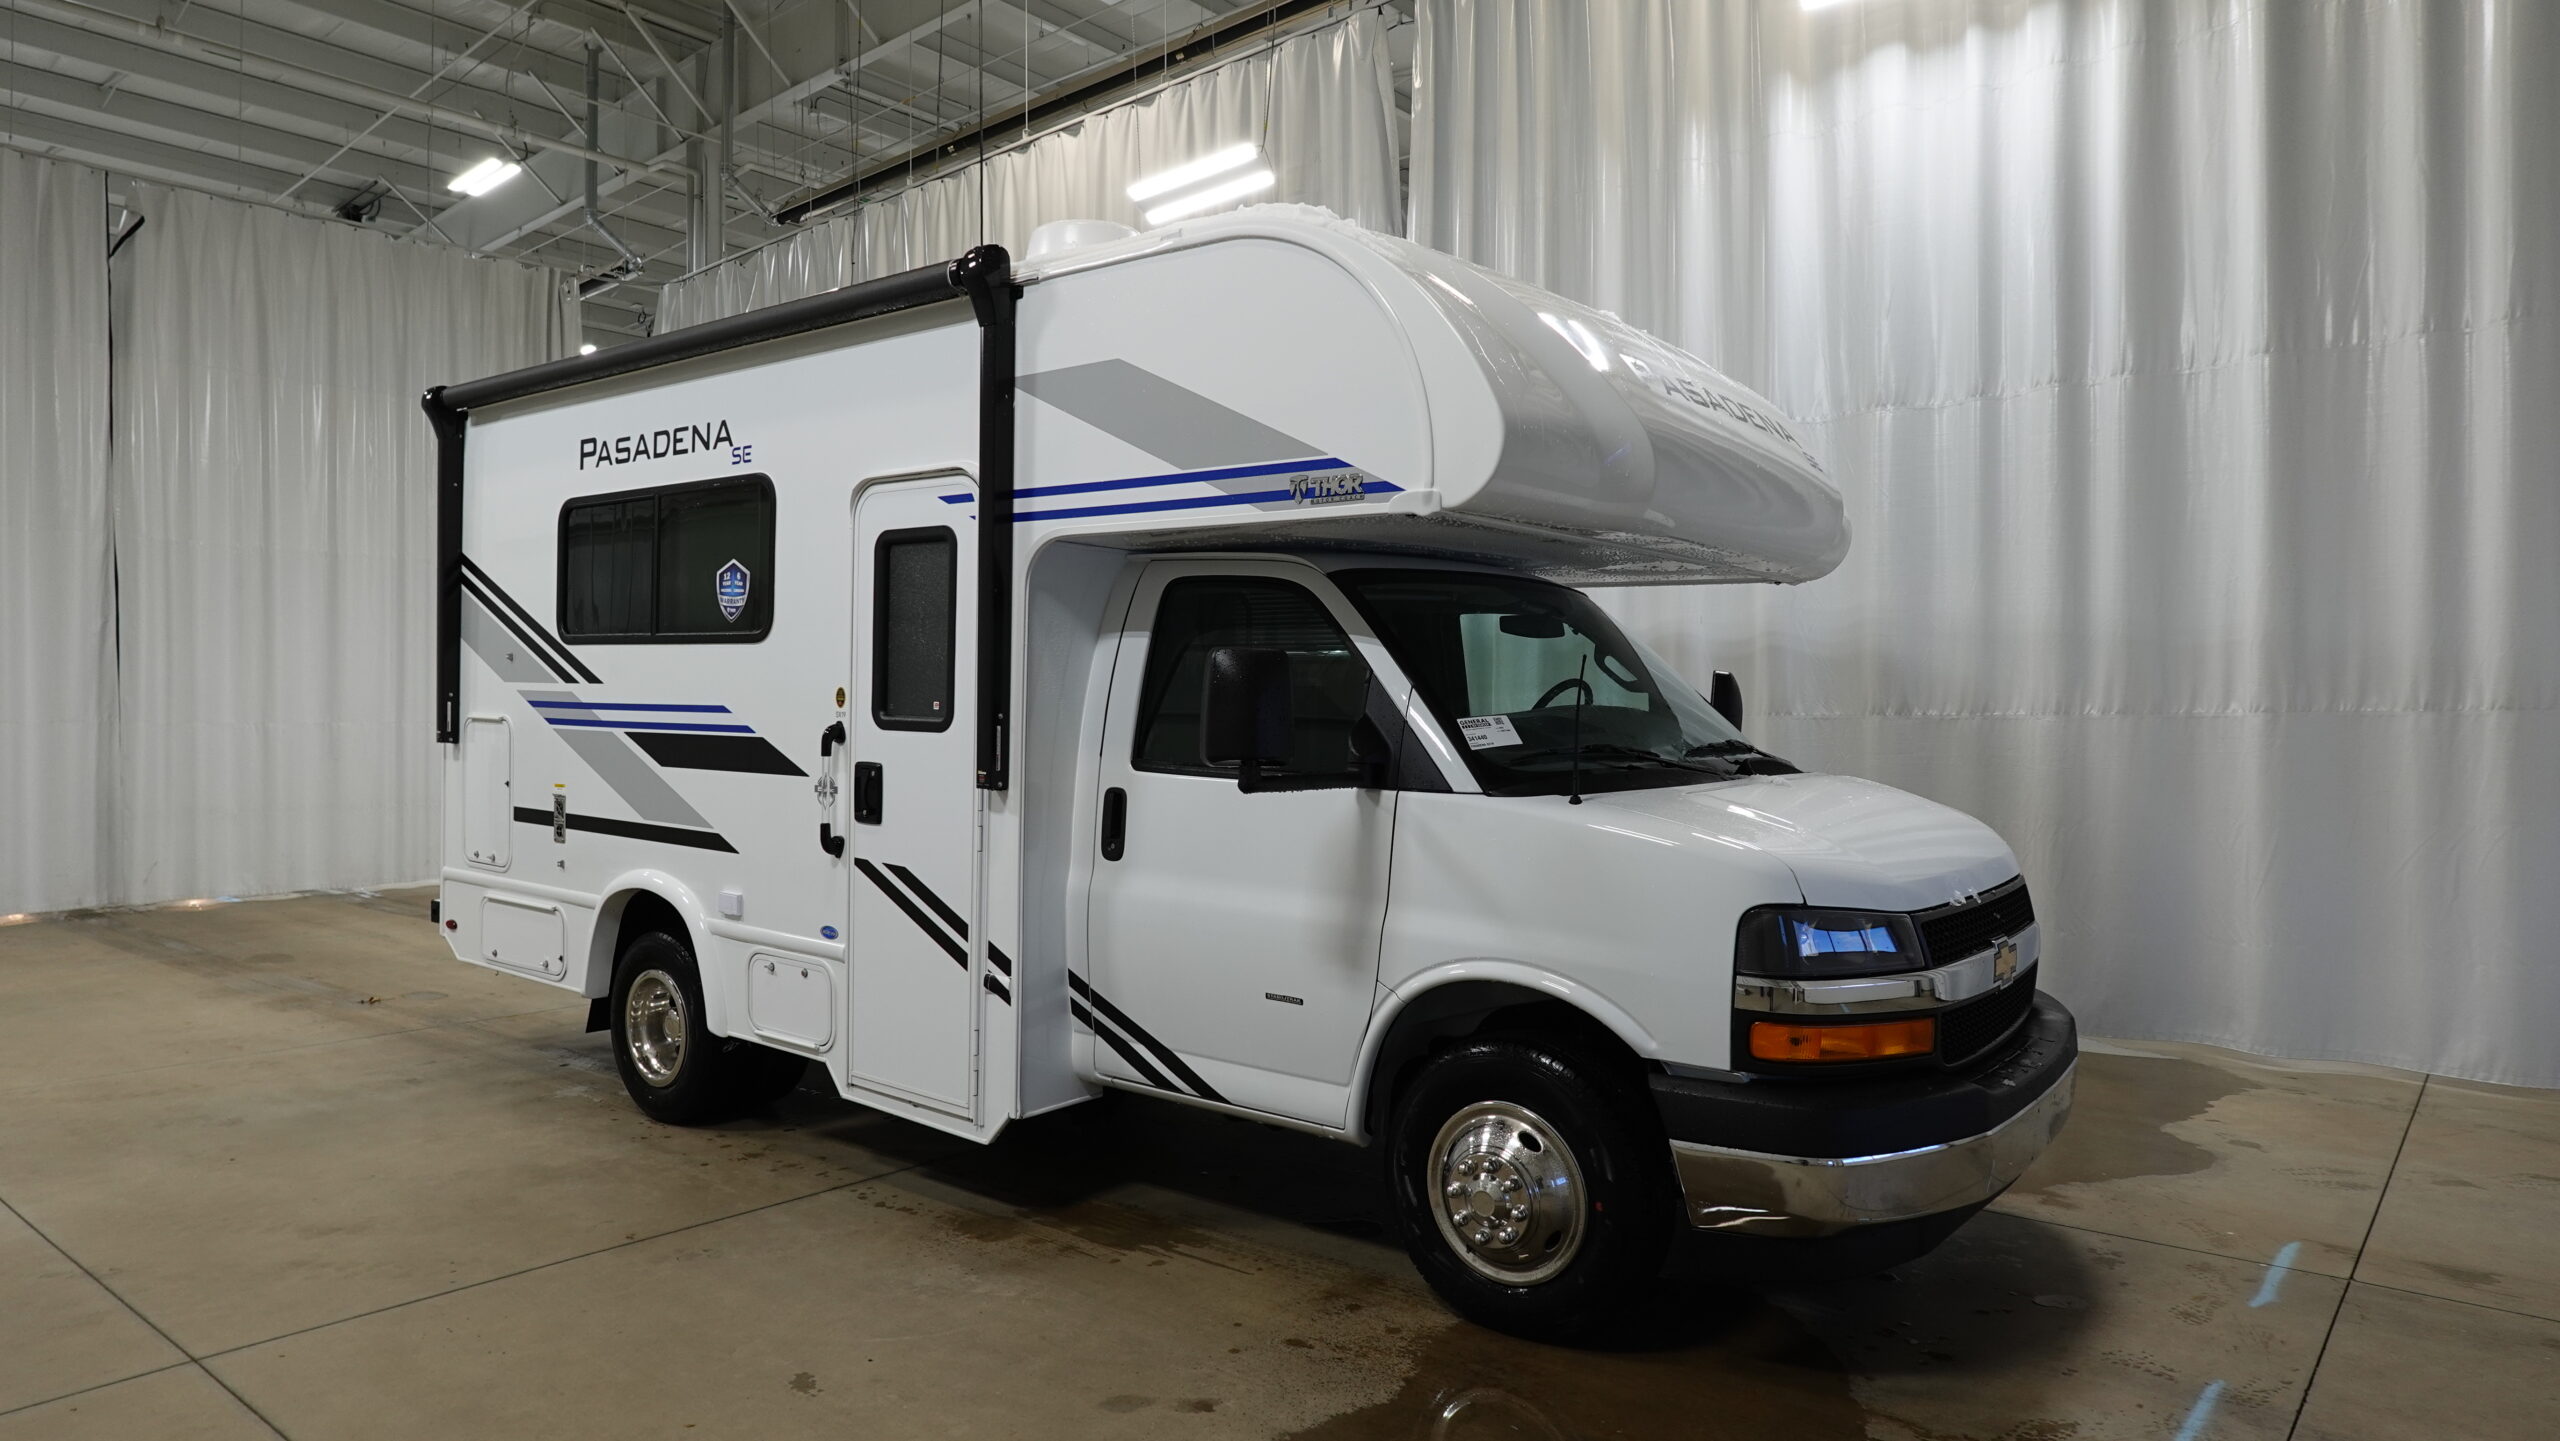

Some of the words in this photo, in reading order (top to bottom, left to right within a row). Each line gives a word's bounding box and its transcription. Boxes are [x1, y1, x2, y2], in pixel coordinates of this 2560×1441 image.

[579, 419, 734, 471] PASADENA
[731, 445, 753, 465] SE
[1310, 473, 1364, 498] THOR
[723, 571, 731, 580] 12
[720, 597, 745, 605] WARRANTY
[1459, 718, 1490, 726] GENERAL
